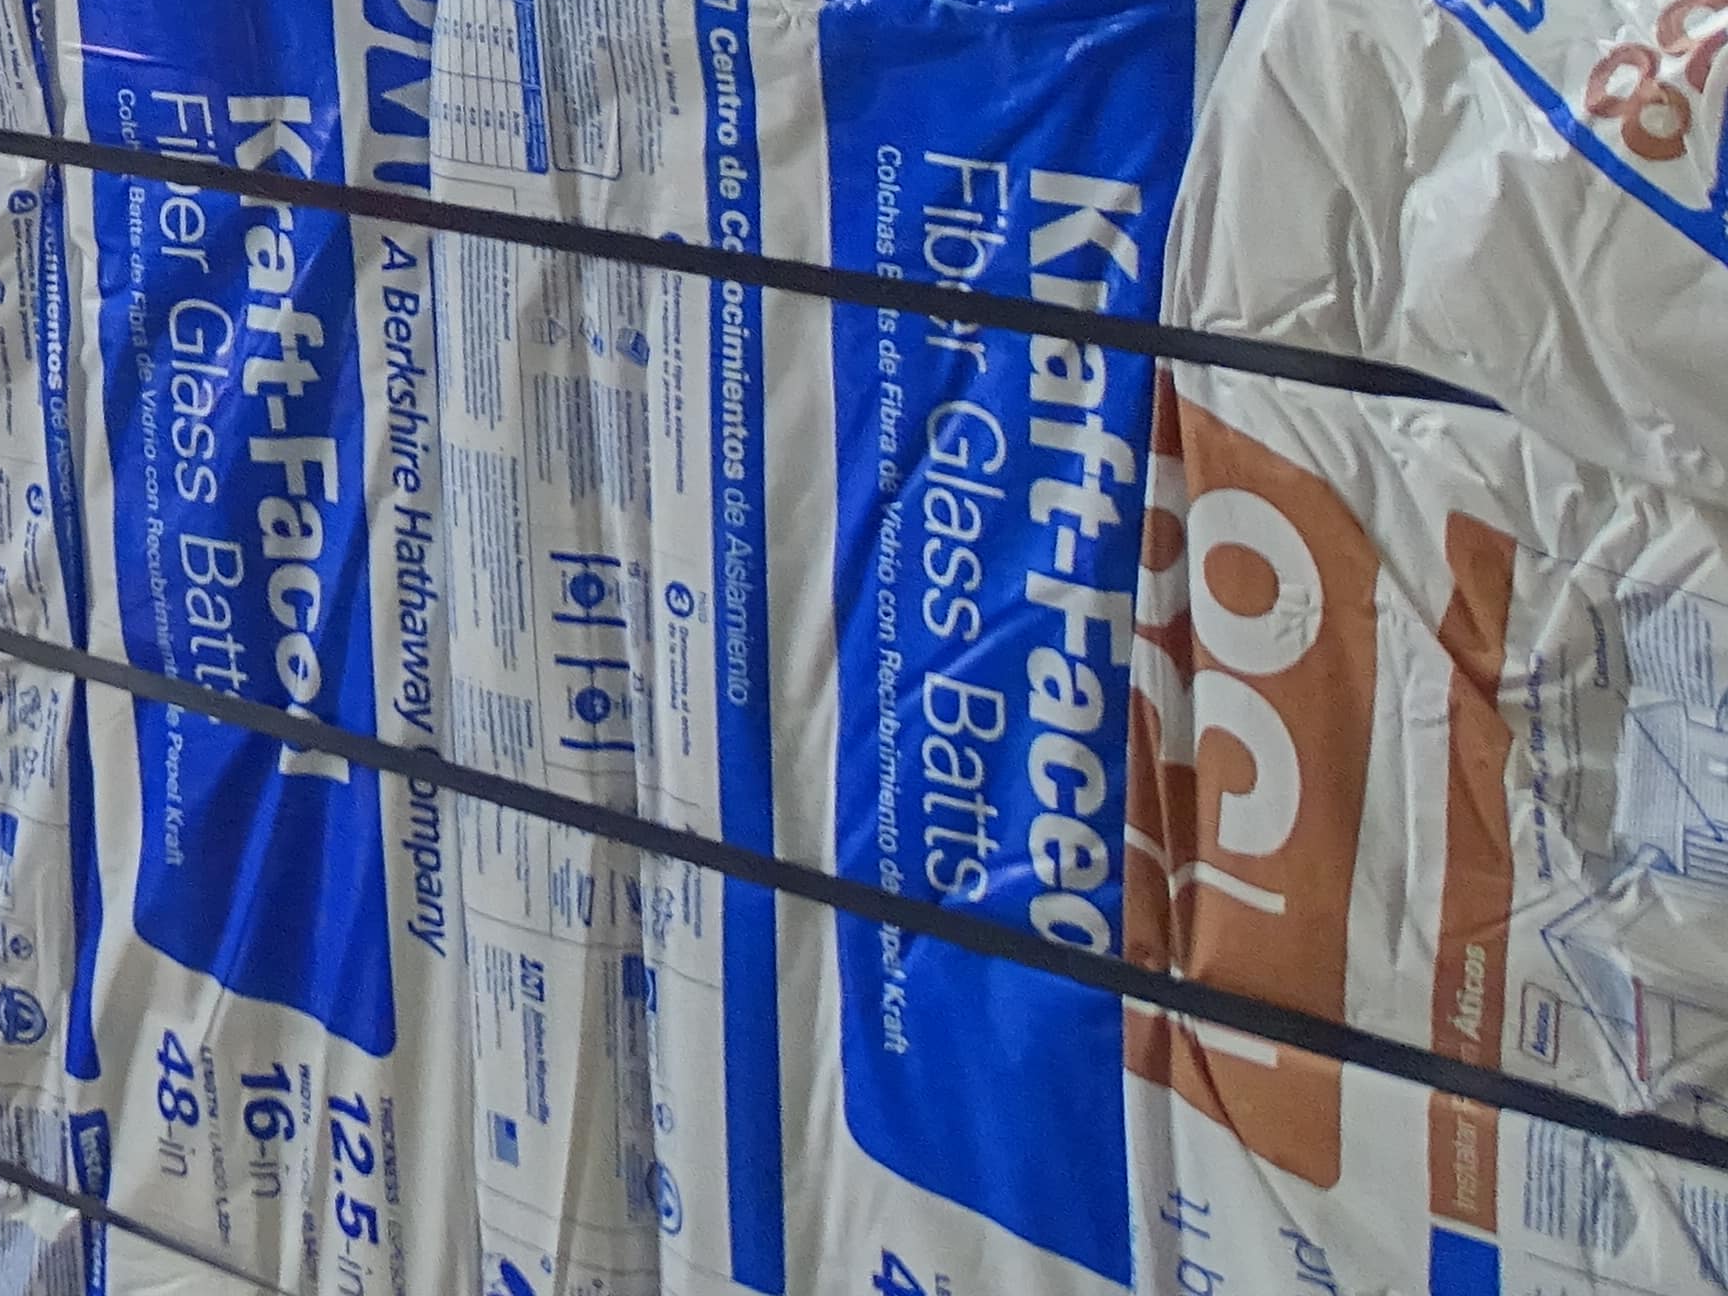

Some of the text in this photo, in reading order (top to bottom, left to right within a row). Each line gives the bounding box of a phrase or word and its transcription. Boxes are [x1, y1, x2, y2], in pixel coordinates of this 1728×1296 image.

[709, 27, 742, 147] Centro
[118, 88, 141, 179] Colch
[719, 157, 747, 201] de
[128, 188, 146, 247] Batts
[875, 144, 903, 257] Colchas
[720, 209, 750, 480] Coocimientos
[877, 338, 901, 376] de
[141, 389, 159, 461] Vidrio
[169, 297, 232, 506] Glass
[878, 381, 904, 454] Fibra
[145, 465, 161, 510] con
[724, 487, 754, 527] de
[878, 458, 901, 493] de
[922, 399, 1007, 642] Glass
[876, 501, 904, 582] Vidrio
[146, 517, 179, 682] Recubrimient
[179, 531, 247, 722] Batt
[381, 237, 448, 958] A Berkshire Hathaway ompany
[724, 531, 754, 708] Aislamiento
[876, 590, 898, 642] con
[165, 732, 185, 803] Papel
[876, 648, 903, 854] Recubrimiento
[921, 671, 1006, 904] Batts
[165, 807, 185, 866] Kraft
[881, 981, 907, 1057] Kraft
[156, 1028, 200, 1179] 48-in
[240, 1060, 296, 1200] 16-in
